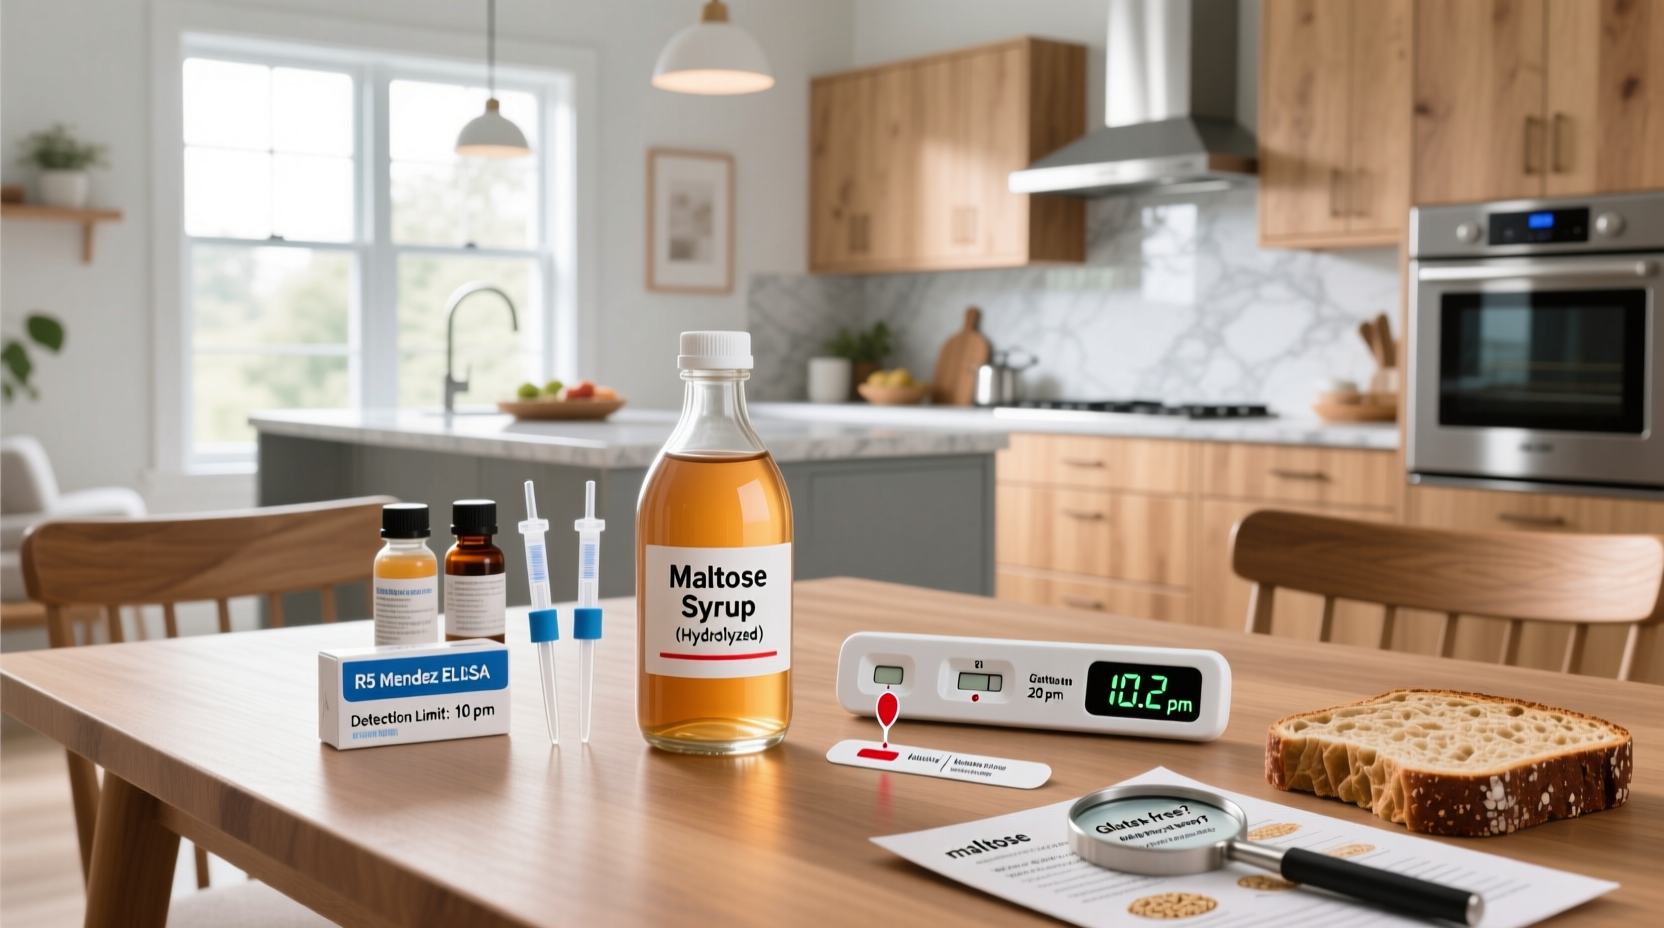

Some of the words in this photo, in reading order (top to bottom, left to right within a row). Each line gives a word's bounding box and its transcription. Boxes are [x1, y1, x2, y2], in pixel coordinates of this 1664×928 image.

[670, 564, 767, 588] Maltose
[681, 594, 756, 624] Syrup
[676, 625, 764, 647] (Hydrolyzed)
[355, 673, 376, 689] R5
[380, 668, 438, 688] Mendez
[1027, 687, 1043, 699] 20
[1045, 691, 1064, 703] pm
[1109, 673, 1168, 710] 10.2
[1166, 699, 1192, 715] pm
[351, 711, 412, 728] Detection
[415, 707, 450, 723] Limit:
[455, 704, 470, 719] 10
[473, 705, 495, 721] pm
[945, 834, 1031, 859] maltose
